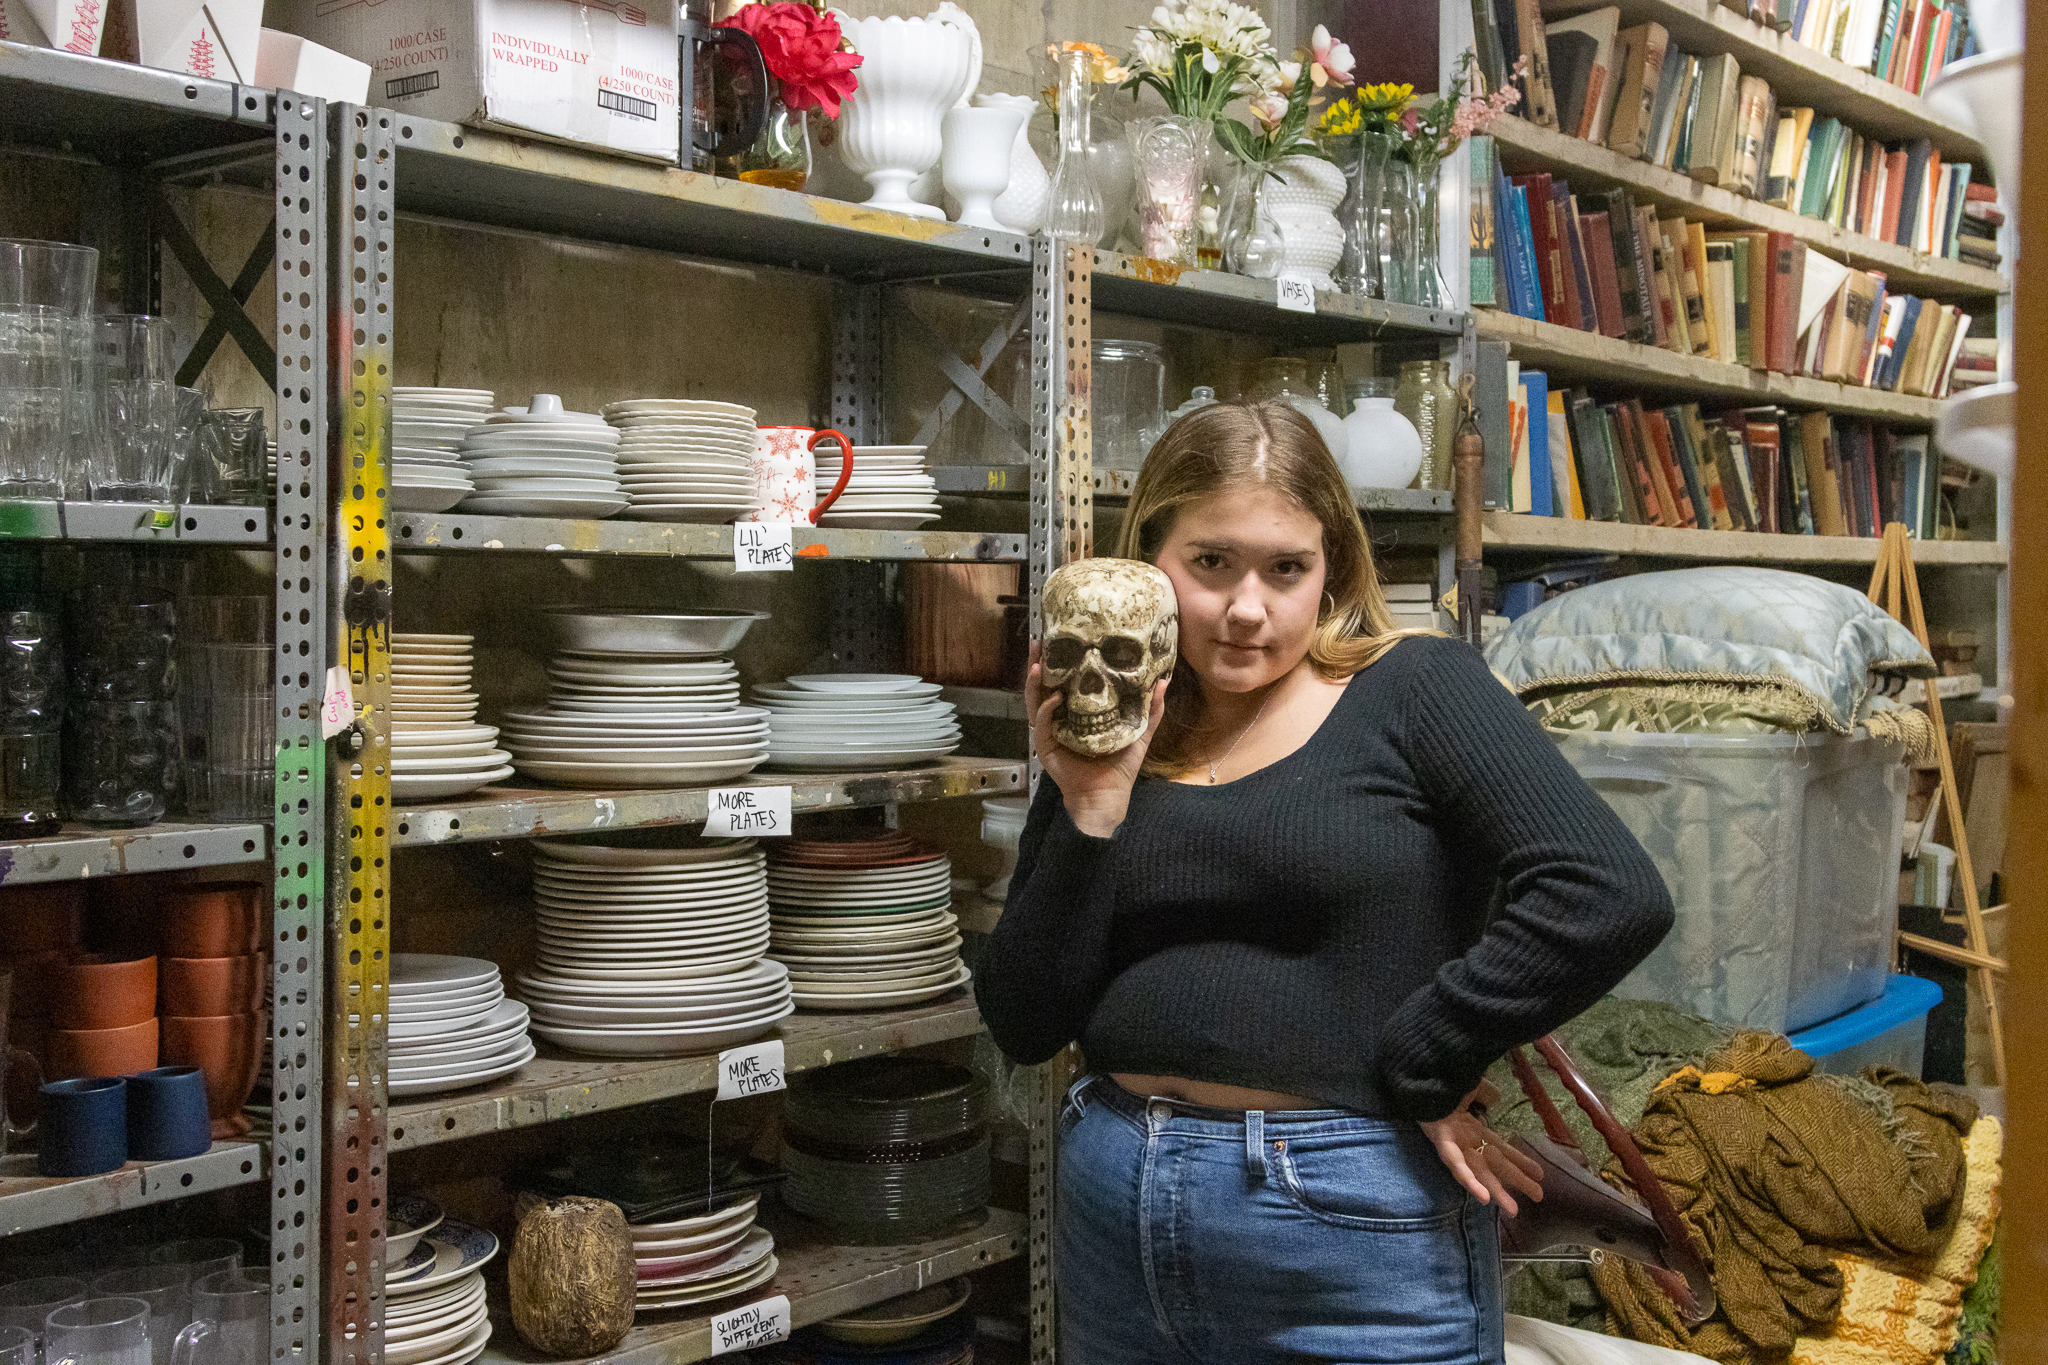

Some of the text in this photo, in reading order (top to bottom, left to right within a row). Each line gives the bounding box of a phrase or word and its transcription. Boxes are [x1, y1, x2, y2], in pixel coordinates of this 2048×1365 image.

[389, 28, 446, 51] 1000/CASE
[492, 32, 589, 65] INDIVIDUALLY
[371, 46, 448, 75] (4/250 COUNT)
[492, 48, 558, 73] WRAPPED
[598, 75, 675, 107] (4/250 COUNT)
[620, 65, 674, 91] 1000/CASE
[1281, 278, 1311, 306] VASES
[747, 542, 793, 565] PLATES
[718, 791, 757, 810] MORE
[730, 809, 777, 831] PLATES
[728, 1055, 760, 1081] MORE
[738, 1068, 781, 1095] PLATES
[716, 1307, 760, 1337] SLIGHTLY
[722, 1314, 779, 1349] DIFFERENT
